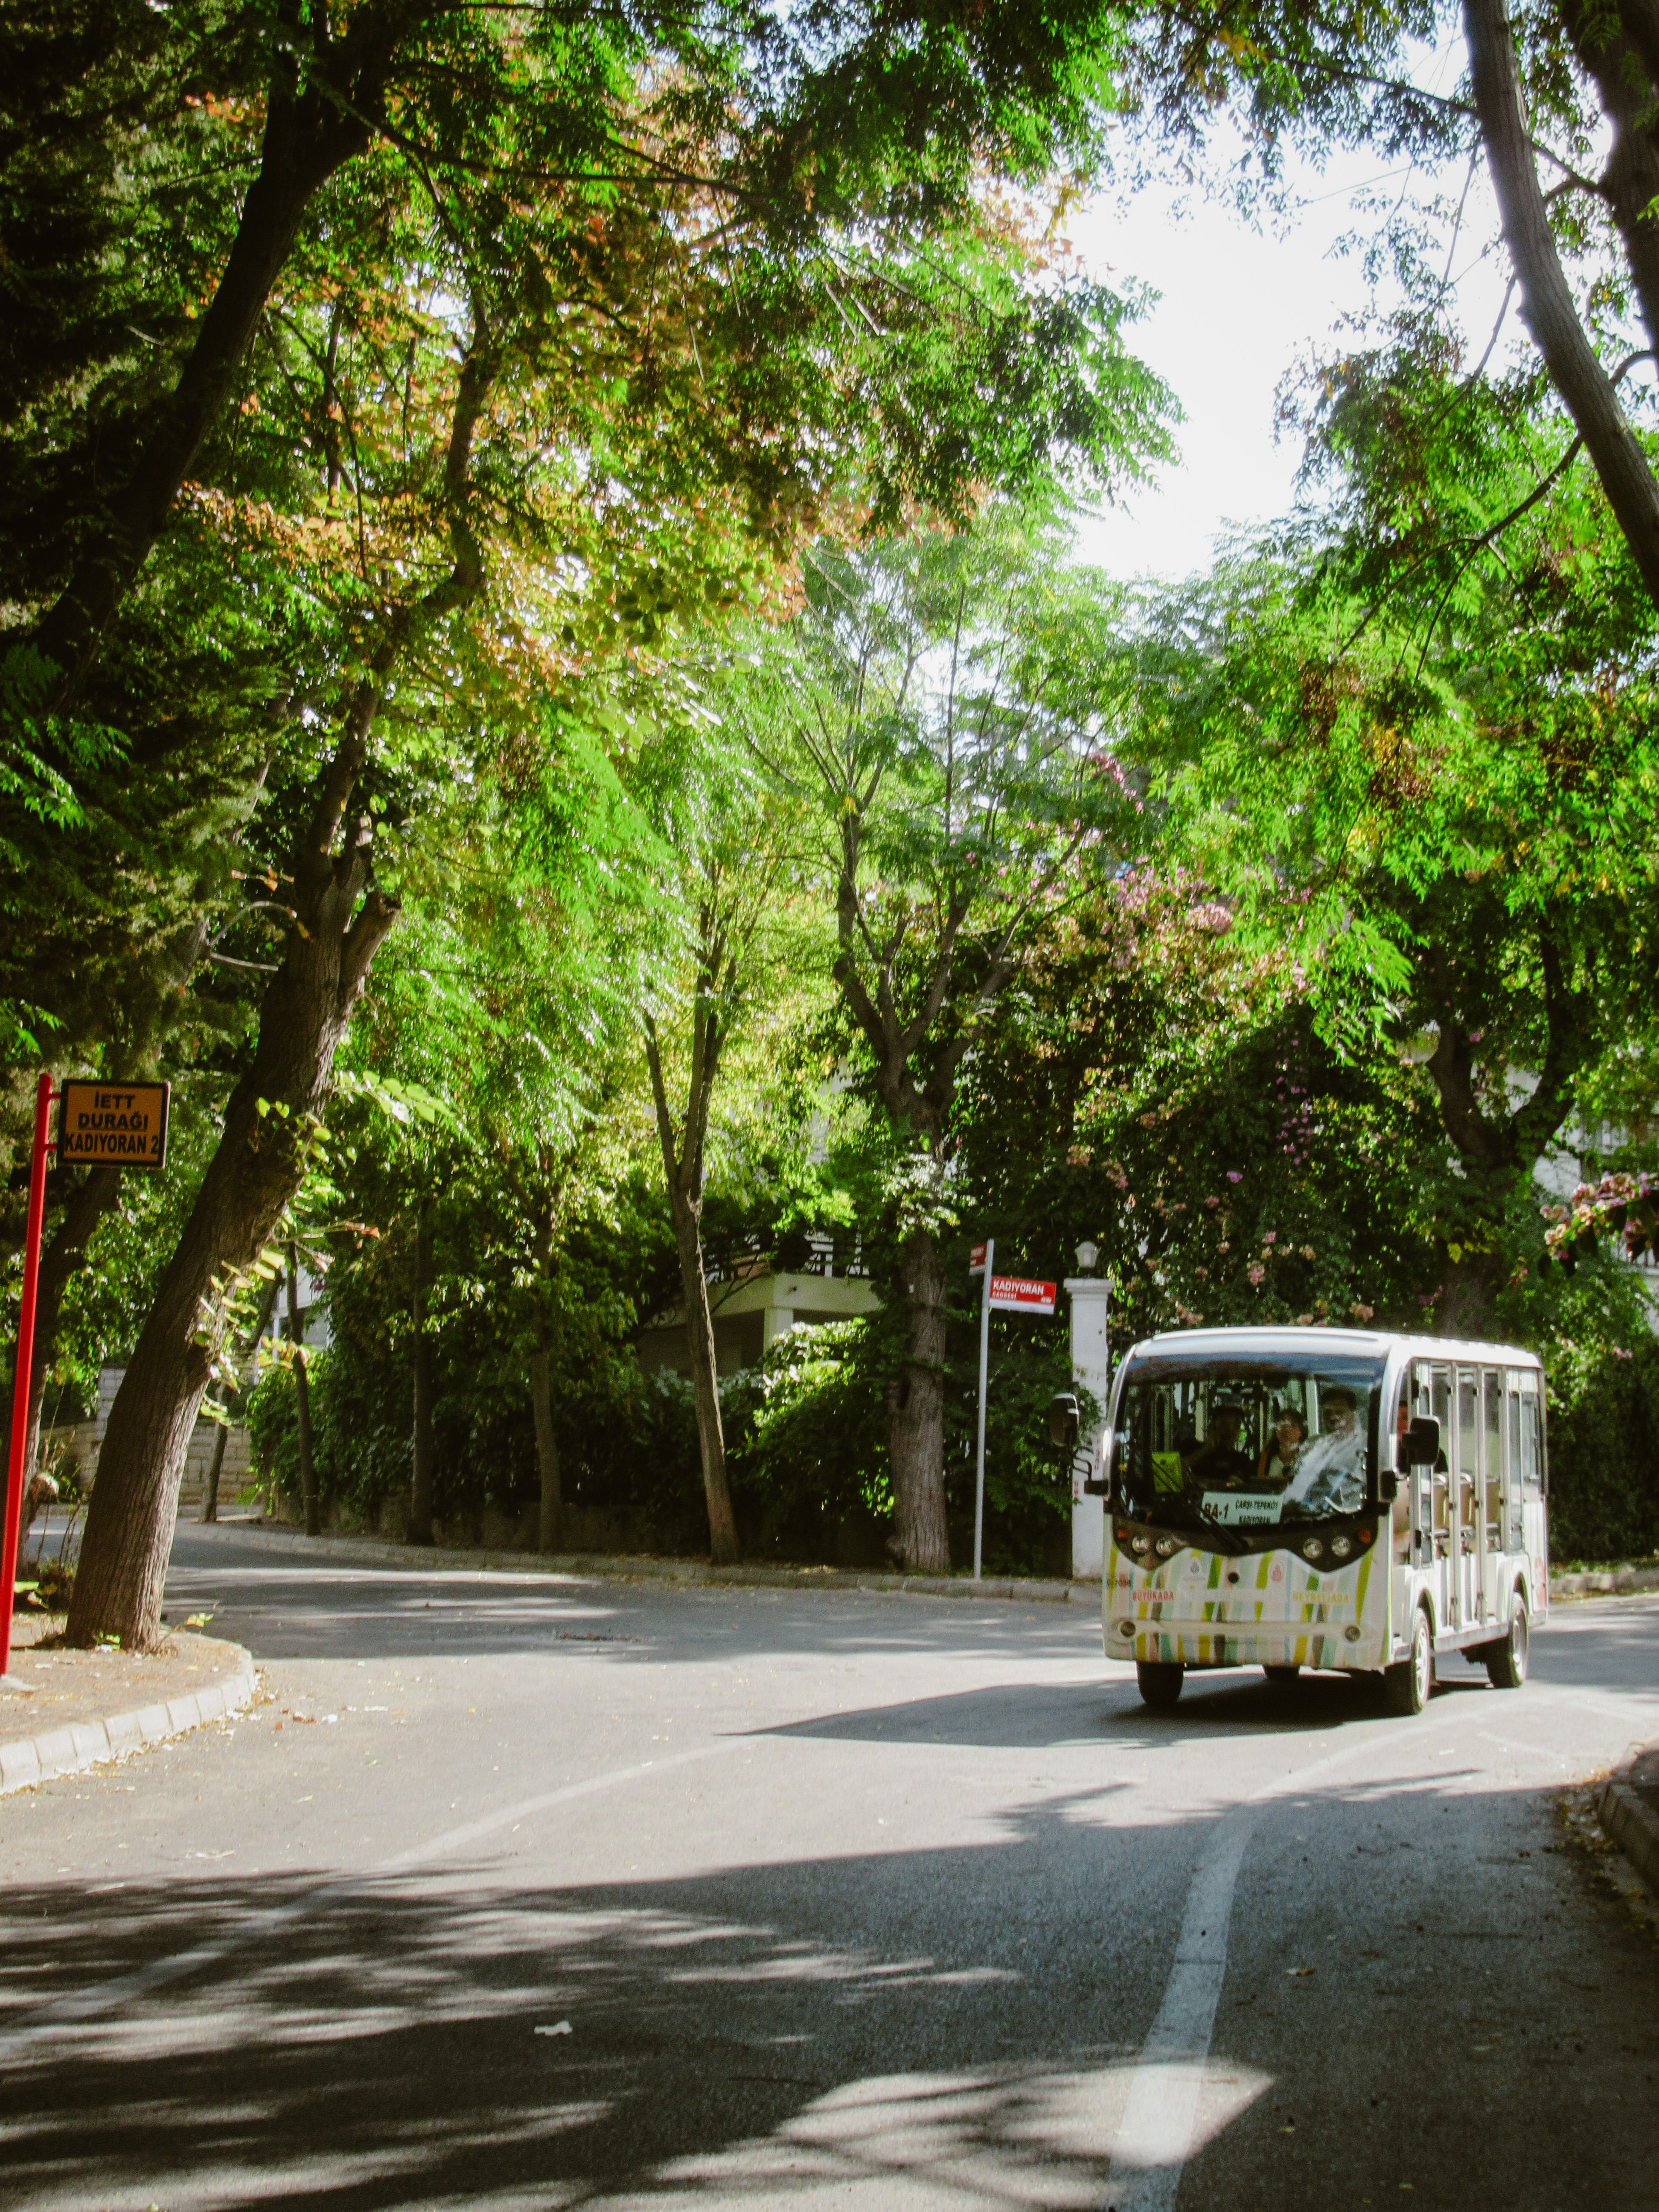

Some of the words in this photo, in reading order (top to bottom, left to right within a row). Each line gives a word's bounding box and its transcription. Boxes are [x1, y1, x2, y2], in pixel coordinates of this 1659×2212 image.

[78, 1111, 148, 1130] DURAĞI
[65, 1133, 147, 1154] KADIYORAN
[150, 1136, 159, 1154] 2
[993, 1280, 1044, 1295] KADIYORAN
